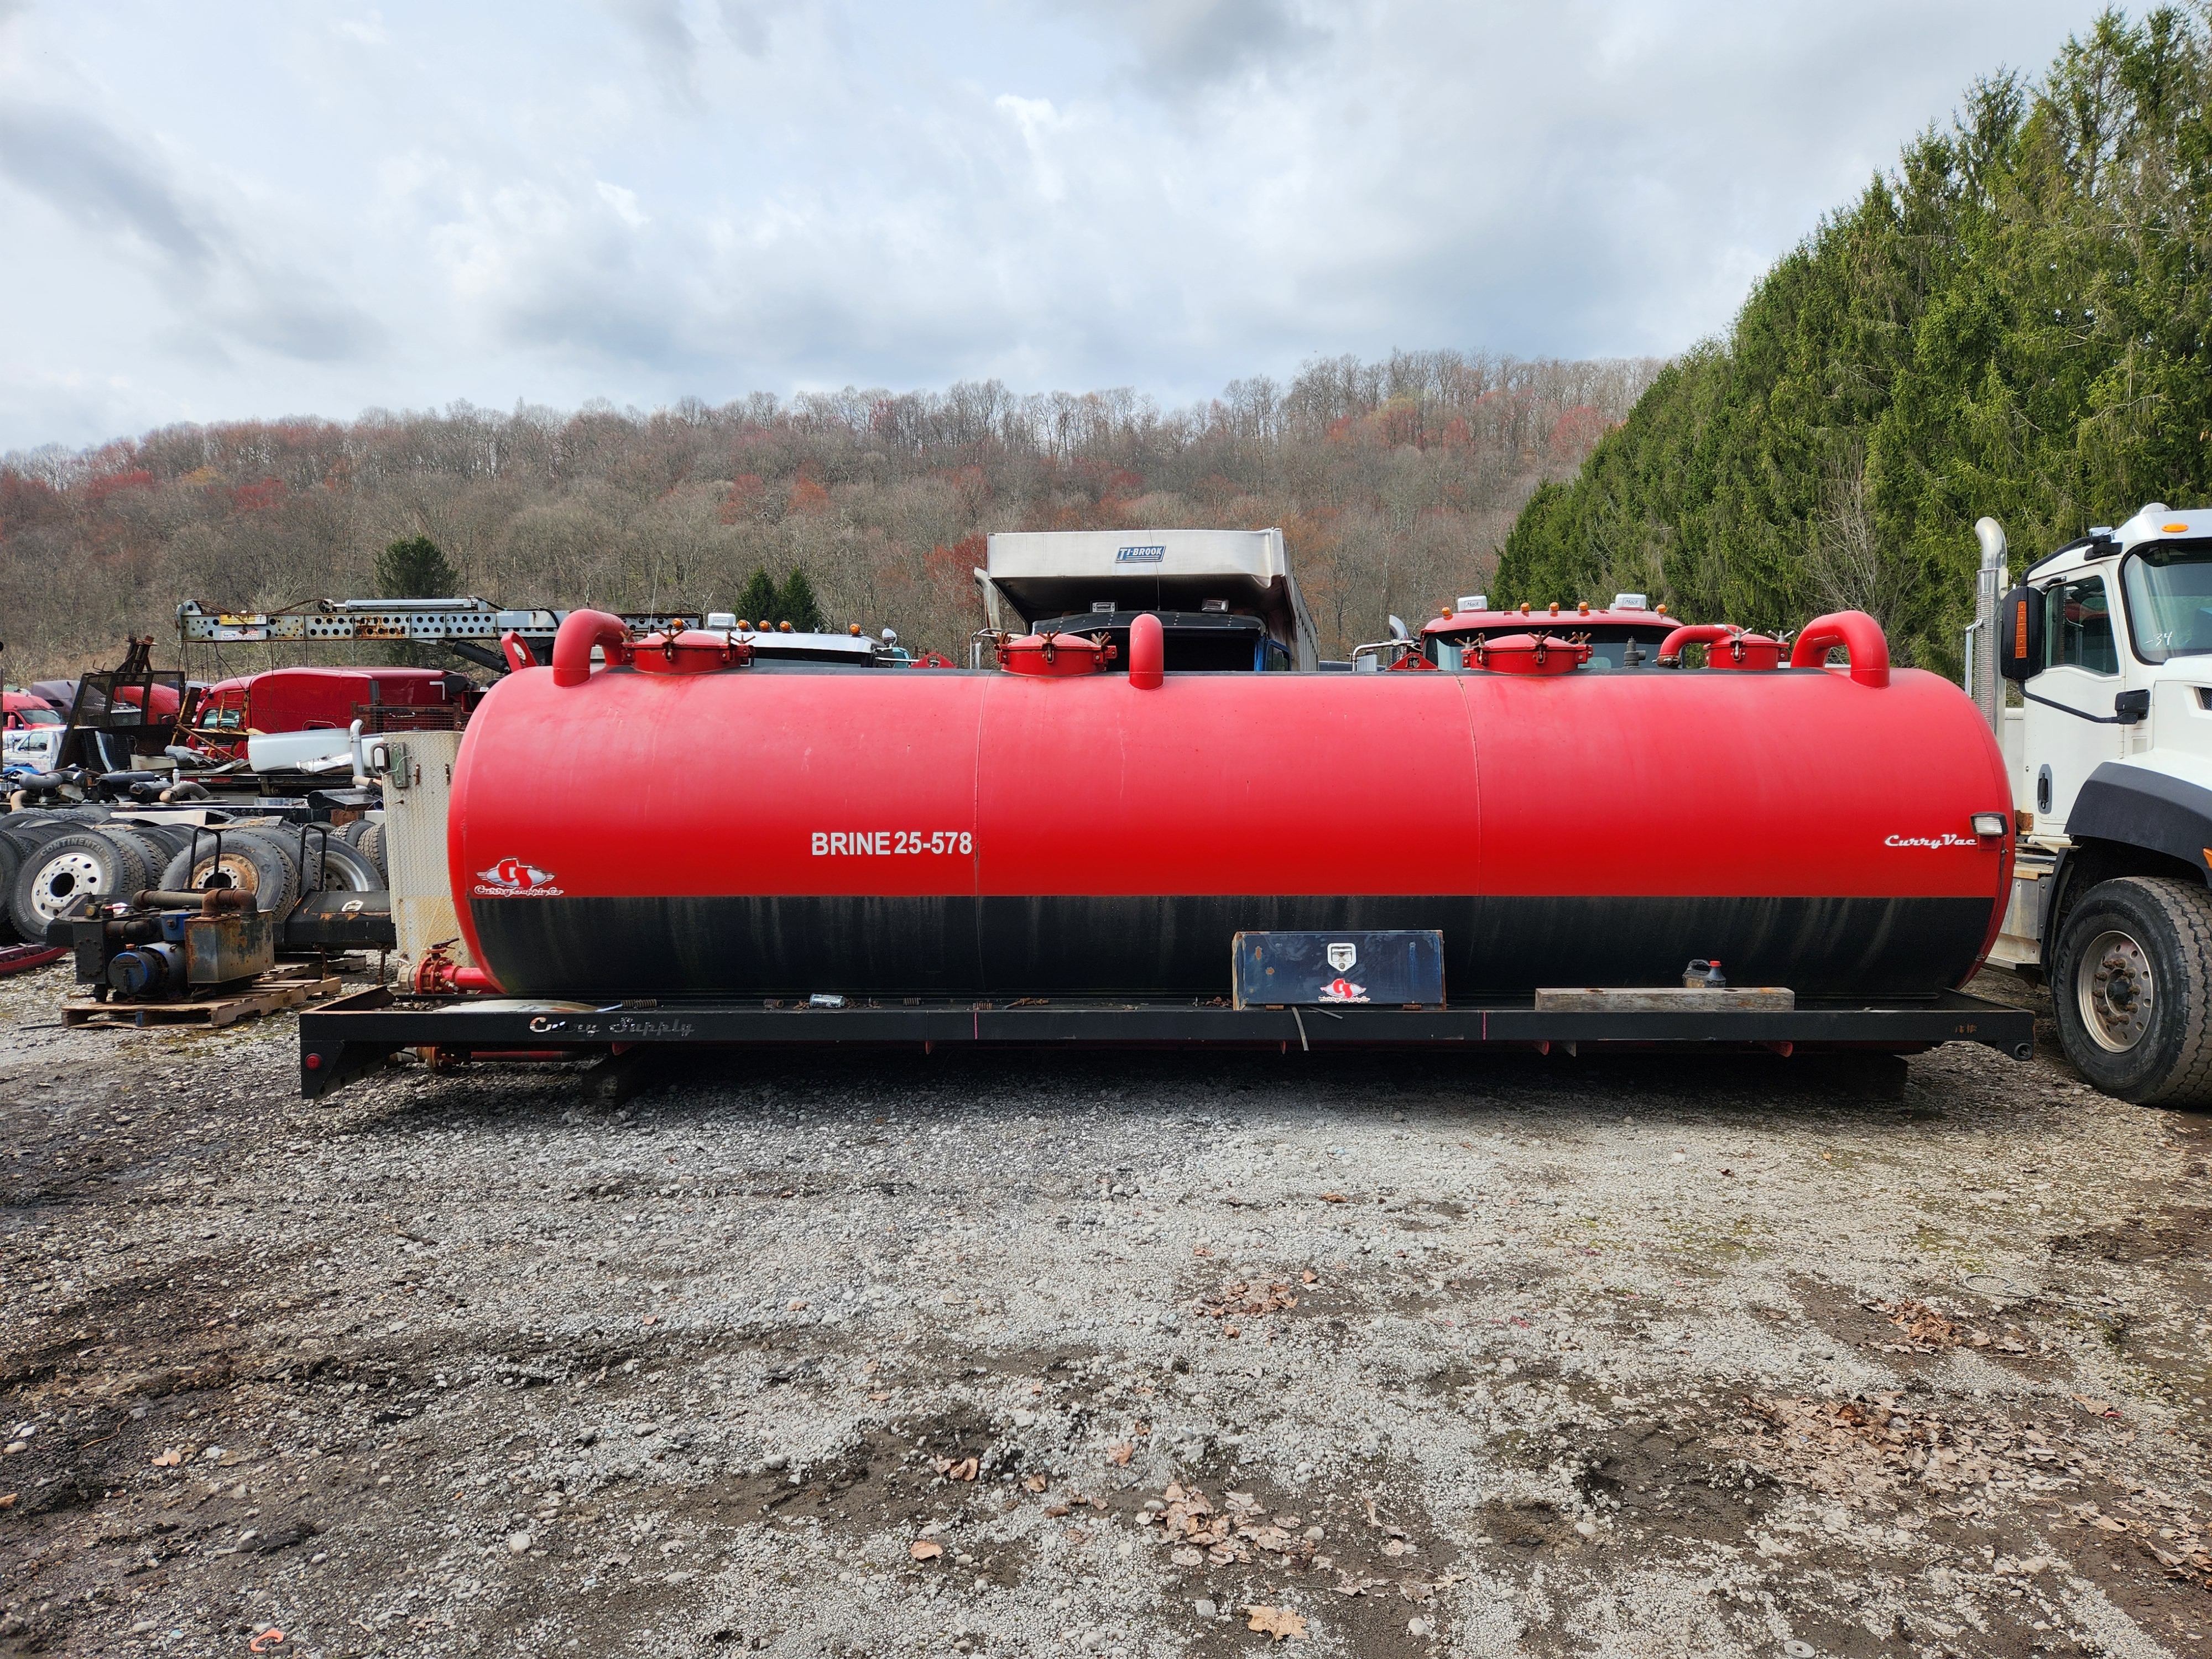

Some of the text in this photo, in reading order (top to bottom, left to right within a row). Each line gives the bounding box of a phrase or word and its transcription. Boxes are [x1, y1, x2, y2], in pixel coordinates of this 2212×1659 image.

[40, 838, 104, 857] CONTINENTAL
[812, 831, 972, 855] BRINE 25-578
[1885, 834, 1978, 849] CurryVac
[474, 885, 510, 897] Curry
[512, 887, 546, 896] Supply
[609, 1016, 695, 1037] Supply
